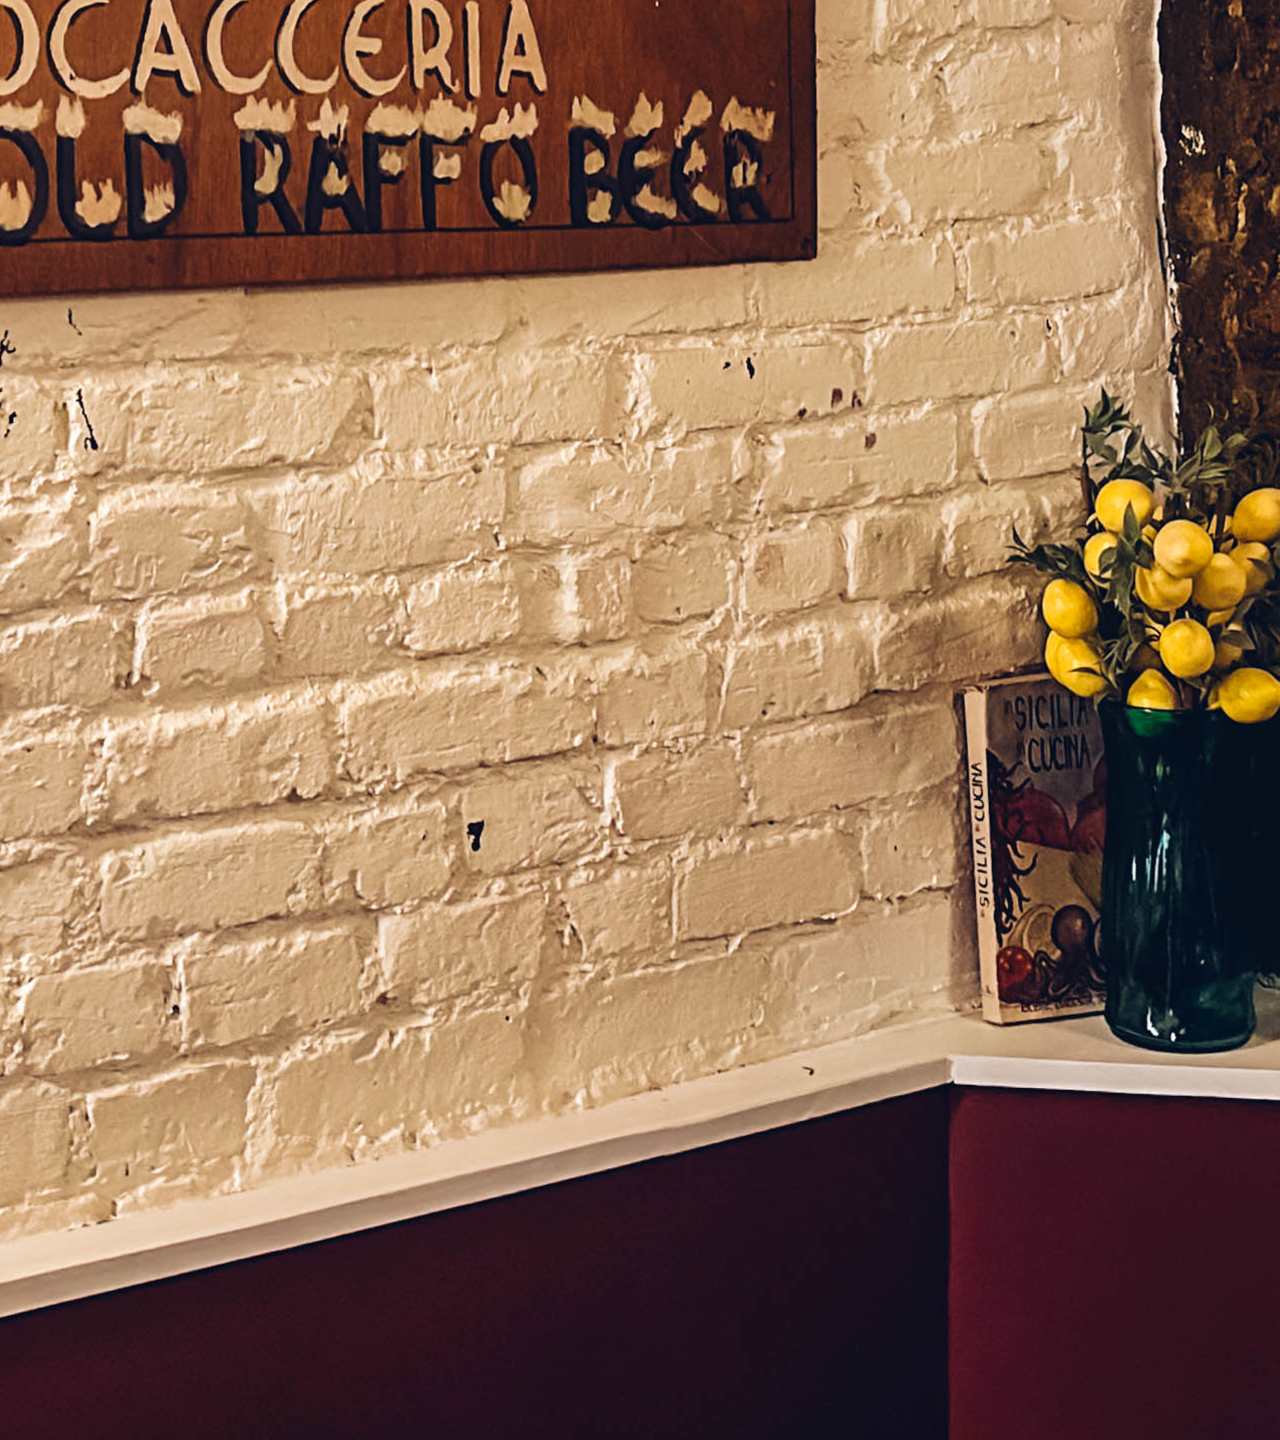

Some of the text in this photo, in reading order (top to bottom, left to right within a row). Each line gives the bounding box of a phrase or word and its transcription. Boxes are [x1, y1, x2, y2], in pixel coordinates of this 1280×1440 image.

[234, 92, 540, 234] RAFFO
[569, 89, 777, 230] BEER
[1014, 694, 1090, 731] SICILIA
[1028, 734, 1092, 773] CUCINA
[970, 762, 985, 822] CUCINA
[977, 835, 991, 909] SICILIA
